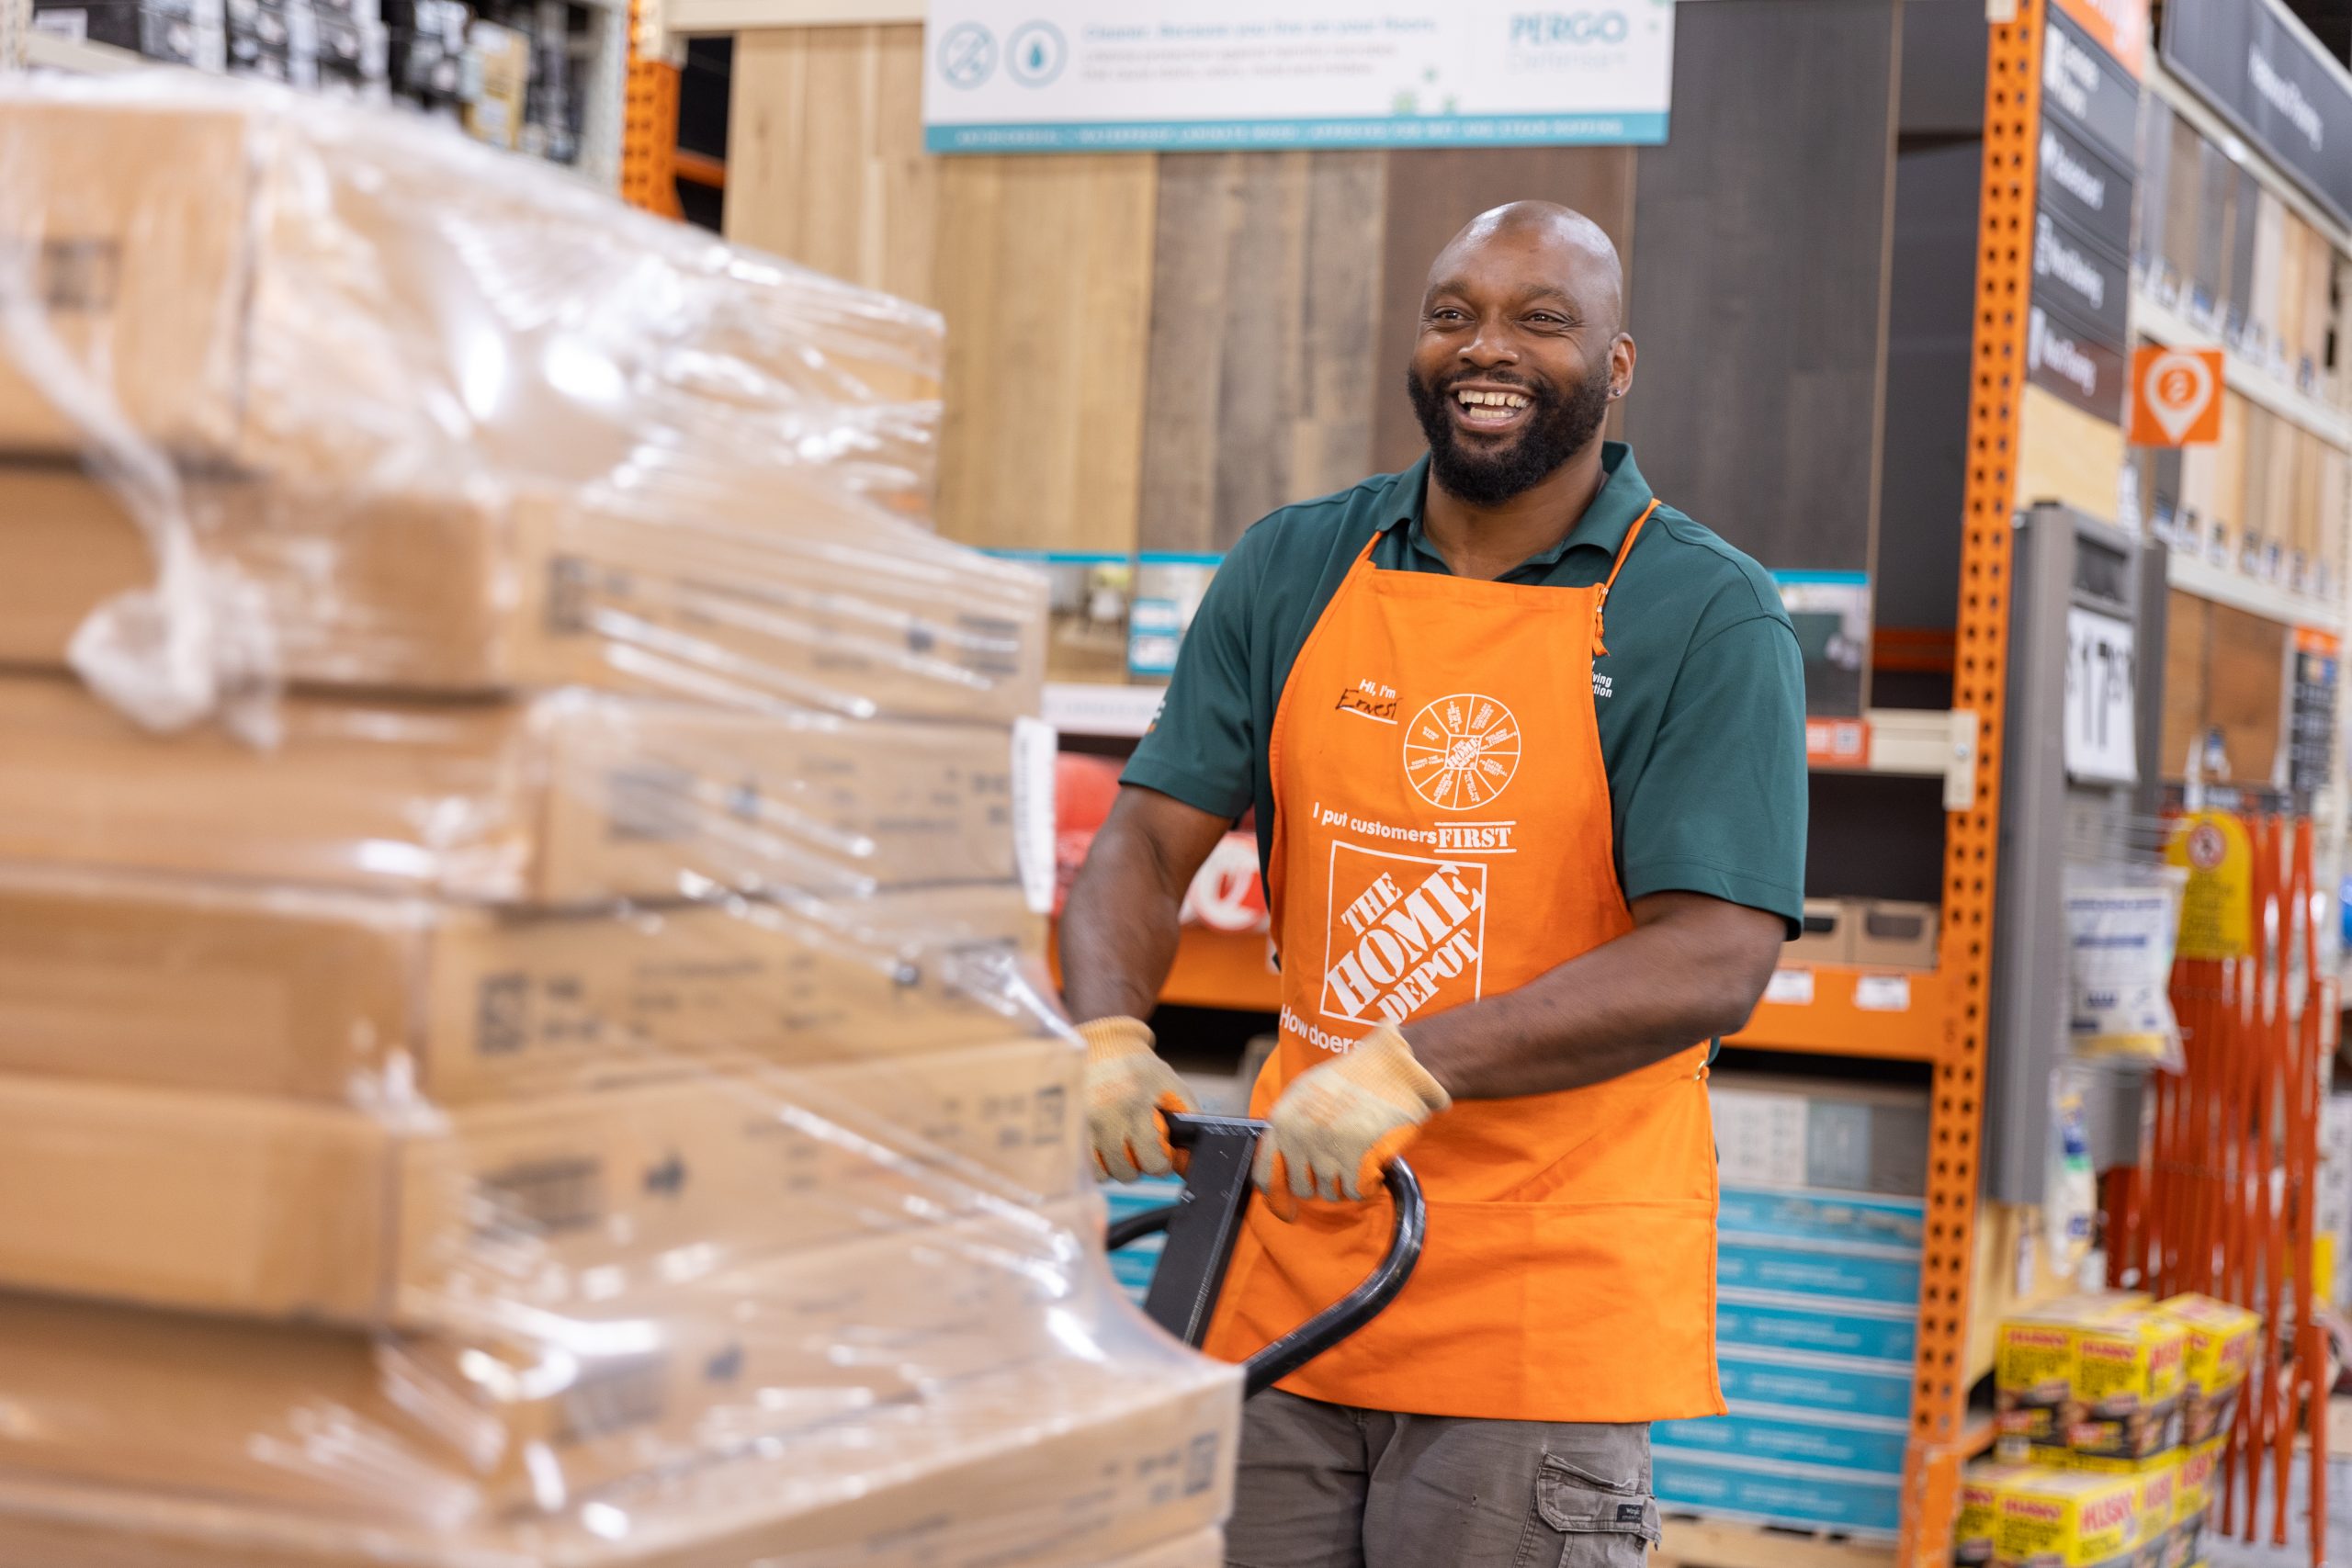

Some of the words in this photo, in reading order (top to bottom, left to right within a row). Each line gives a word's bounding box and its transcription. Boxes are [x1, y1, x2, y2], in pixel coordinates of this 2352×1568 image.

[1510, 10, 1628, 44] PERGO
[1359, 679, 1376, 696] Hi,
[1379, 684, 1396, 699] I'm
[1592, 671, 1612, 688] ving
[1592, 683, 1612, 698] tion
[1312, 801, 1320, 819] I
[1321, 808, 1348, 827] put
[1351, 817, 1438, 844] customers
[1438, 827, 1511, 849] FIRST
[1340, 871, 1404, 937] THE
[1325, 863, 1483, 1018] HOME
[1376, 927, 1479, 1026] DEPOT
[1279, 1002, 1308, 1038] How
